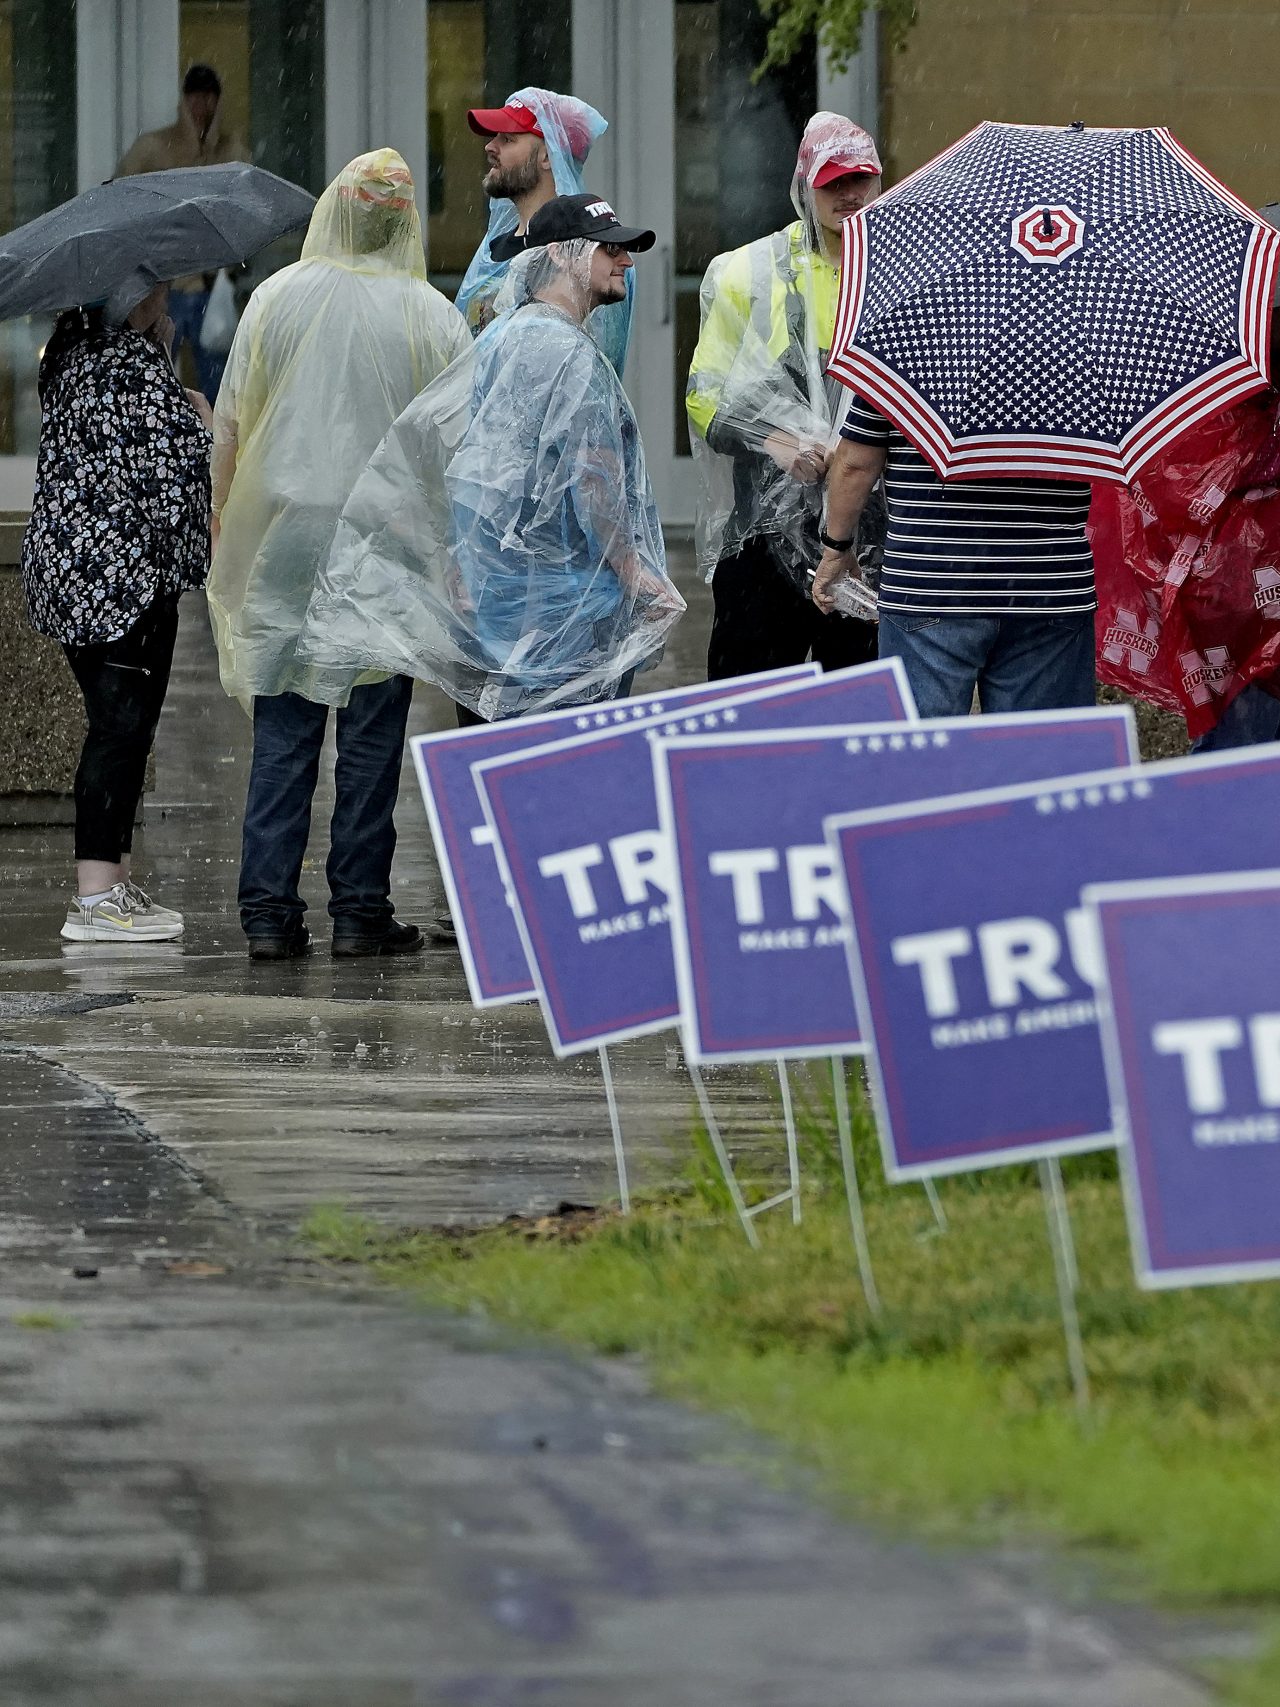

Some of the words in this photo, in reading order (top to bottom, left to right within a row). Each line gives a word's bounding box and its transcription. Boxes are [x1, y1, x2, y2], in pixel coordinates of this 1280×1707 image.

[1104, 628, 1158, 660] HUSKERS
[578, 910, 645, 944] MAKE
[738, 926, 811, 953] MAKE
